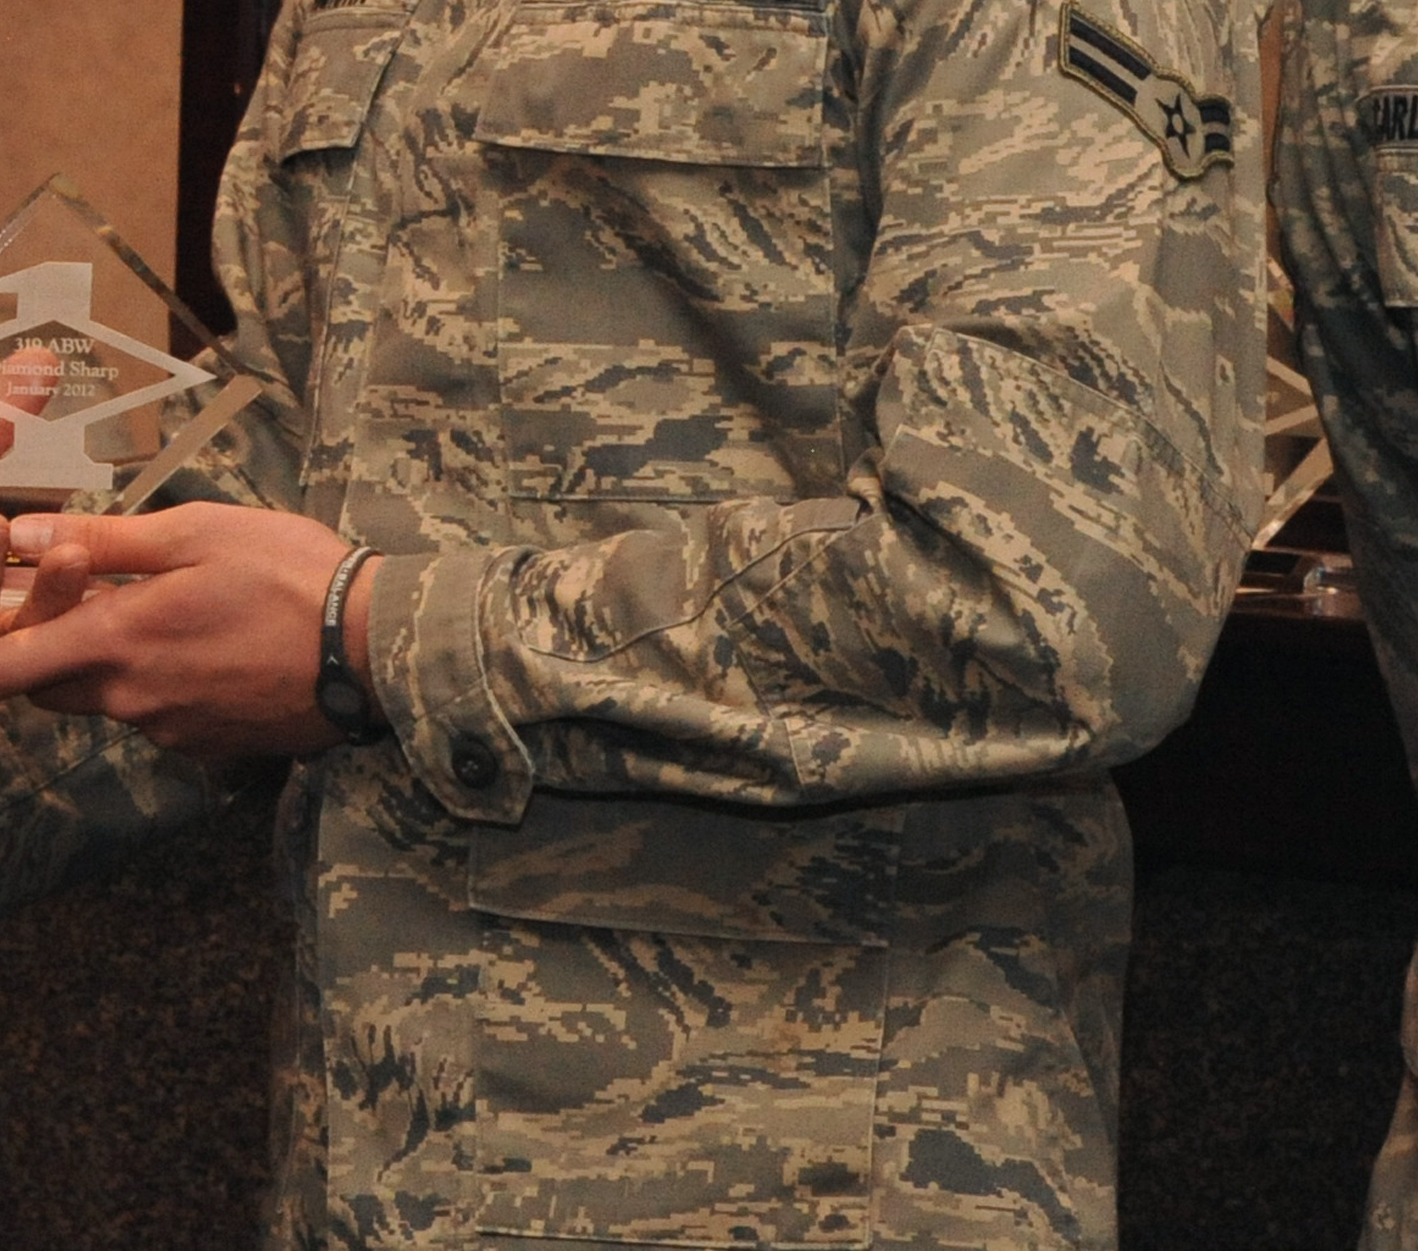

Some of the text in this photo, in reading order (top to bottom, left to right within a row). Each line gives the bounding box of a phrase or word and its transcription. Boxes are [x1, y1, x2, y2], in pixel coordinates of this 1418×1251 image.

[47, 337, 96, 355] ABW
[69, 361, 119, 381] Sharp
[5, 381, 96, 398] January 2012
